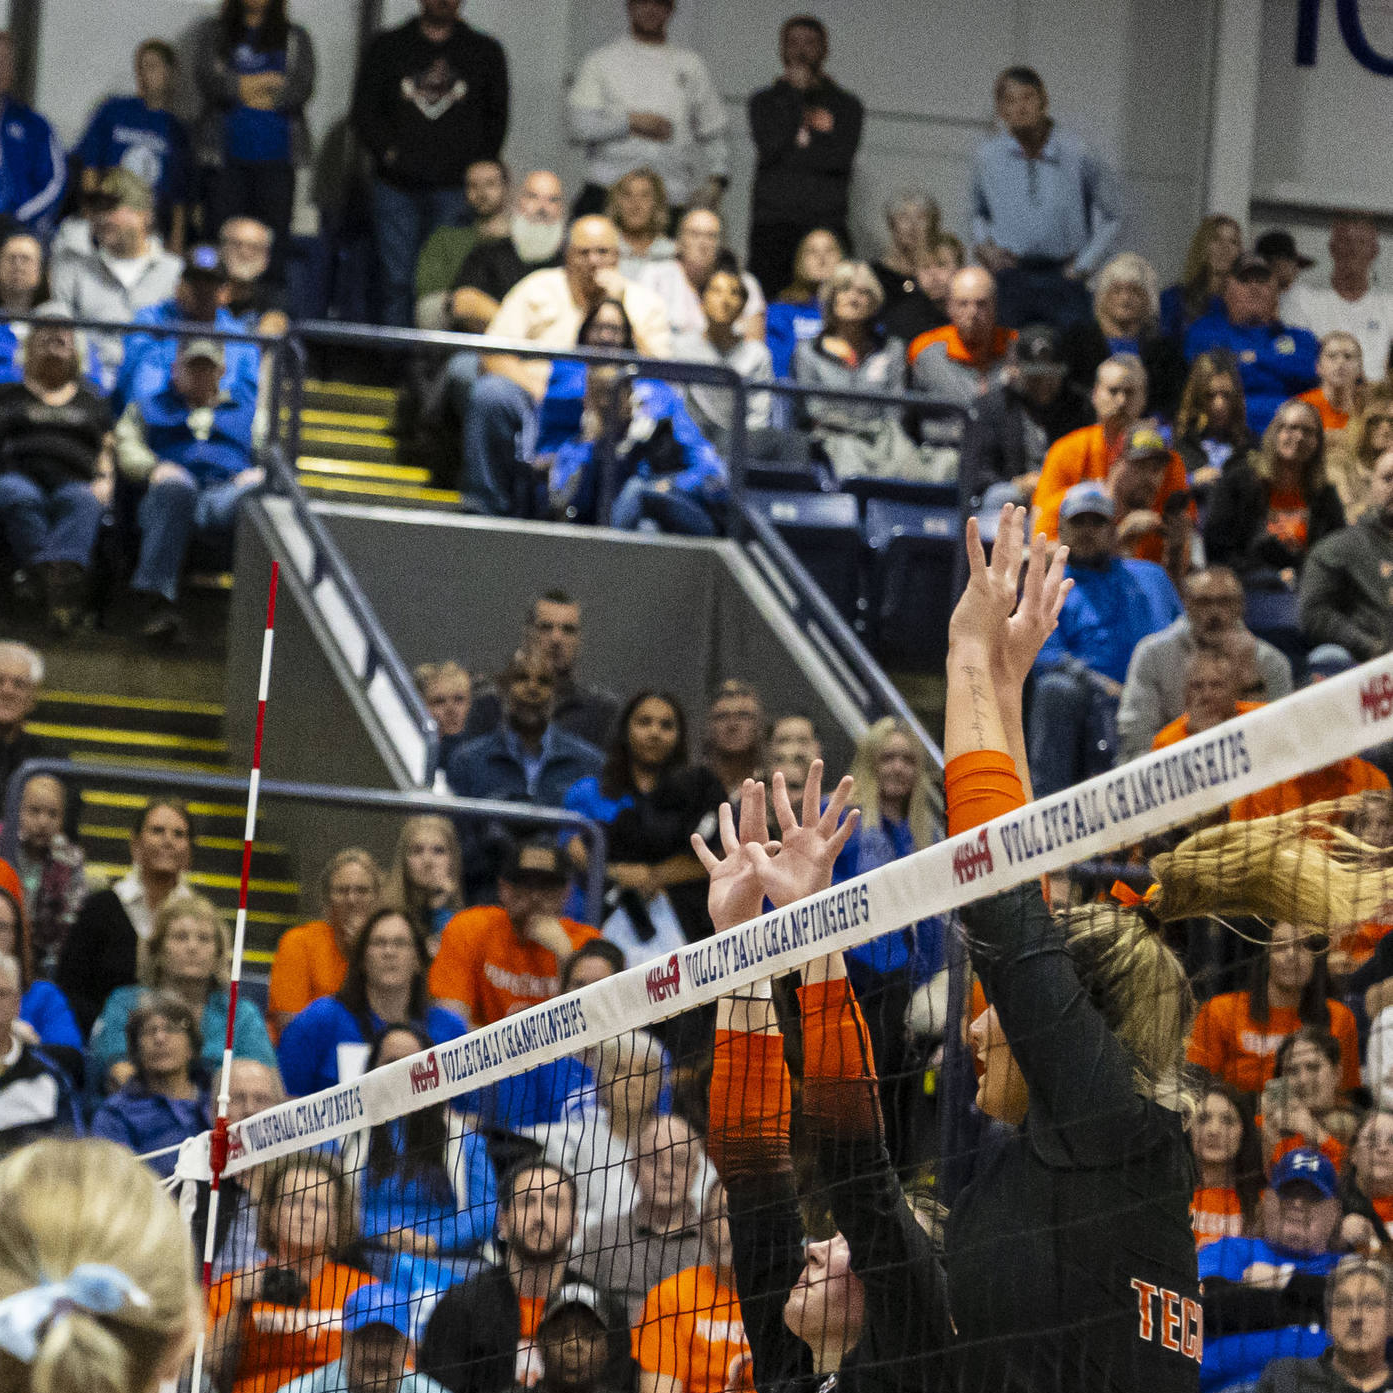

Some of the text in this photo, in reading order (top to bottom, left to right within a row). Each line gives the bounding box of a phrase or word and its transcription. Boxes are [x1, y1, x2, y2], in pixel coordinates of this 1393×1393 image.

[1000, 782, 1106, 867] VOLLEYBALL
[1111, 730, 1253, 824] CHAMPIONSHIPS
[685, 926, 763, 989] VOLLEYBALL
[764, 883, 870, 955] CHAMPIONSHIPS
